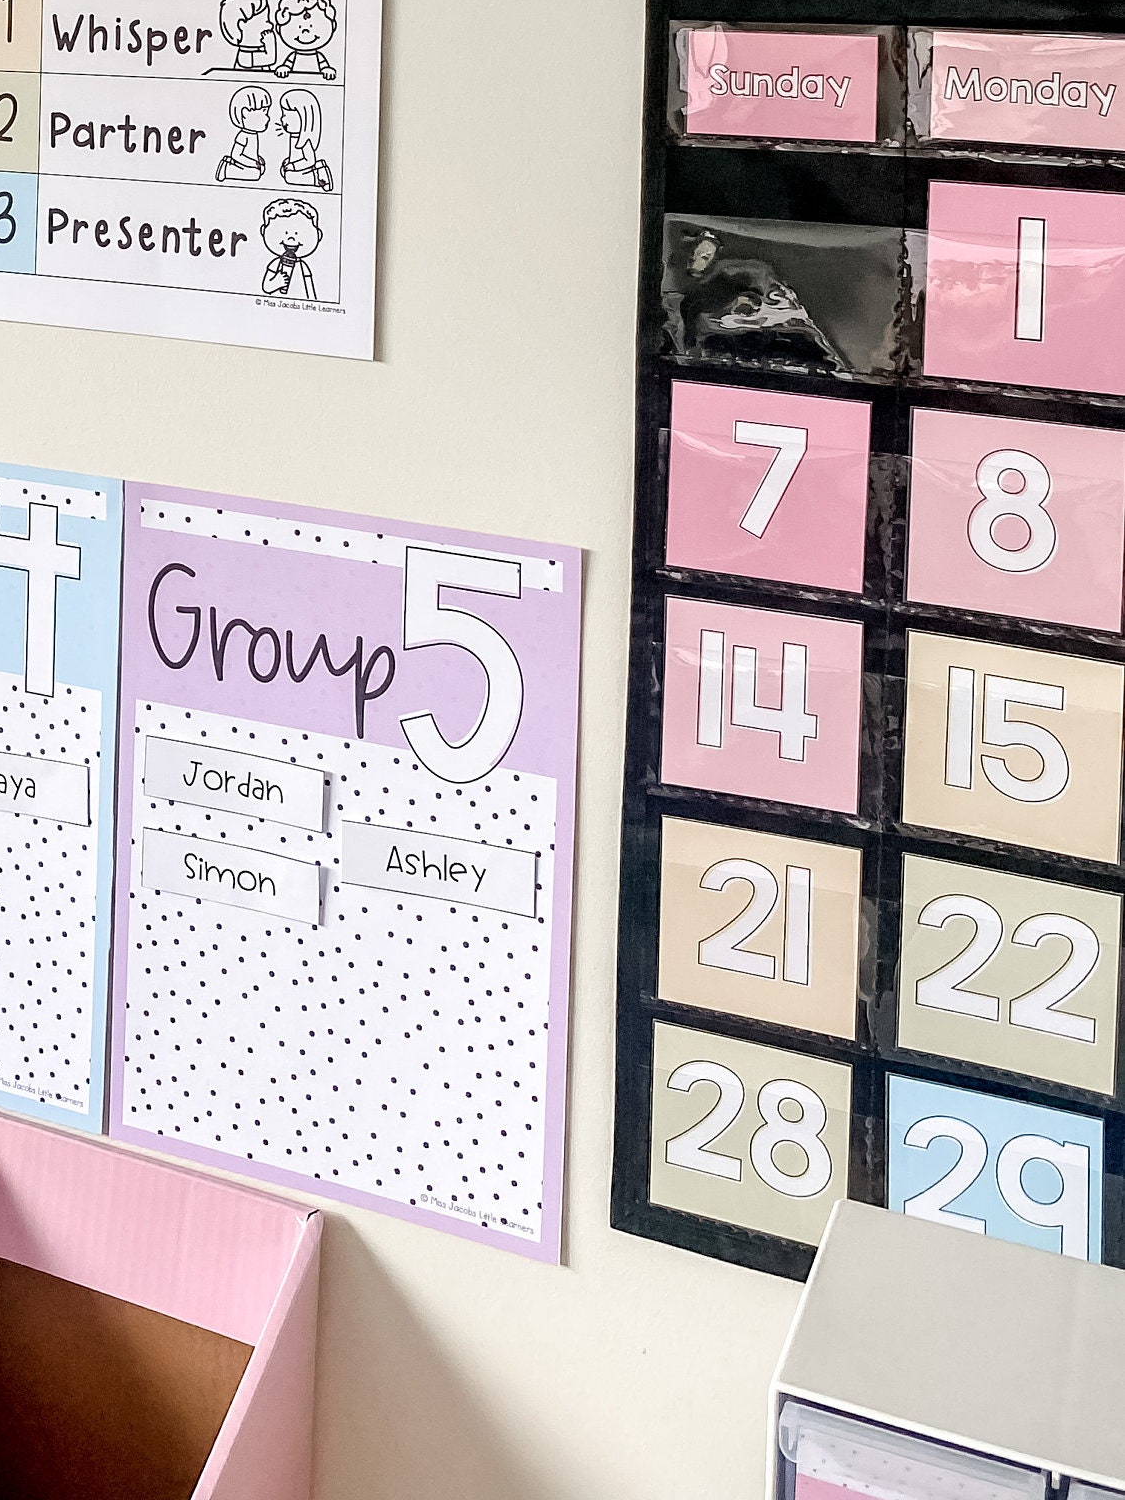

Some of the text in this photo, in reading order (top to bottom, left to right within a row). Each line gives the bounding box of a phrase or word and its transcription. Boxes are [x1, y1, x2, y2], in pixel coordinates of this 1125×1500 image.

[52, 13, 213, 66] Whisper
[709, 63, 851, 108] Sunday
[944, 67, 1116, 116] Monday
[50, 111, 206, 155] Partner
[47, 206, 248, 258] Presenter
[1014, 217, 1046, 341] 1
[277, 301, 300, 310] Jacobs
[734, 420, 808, 539] 7
[967, 449, 1056, 573] 8
[148, 546, 524, 784] Group 5
[695, 627, 819, 764] 14
[183, 761, 284, 803] Jordan
[944, 664, 1071, 803] 15
[183, 853, 276, 896] Simon
[386, 846, 487, 893] Ashley
[697, 858, 813, 987] 21
[914, 893, 1101, 1044] 22
[665, 1059, 833, 1199] 28
[902, 1115, 1089, 1261] 29
